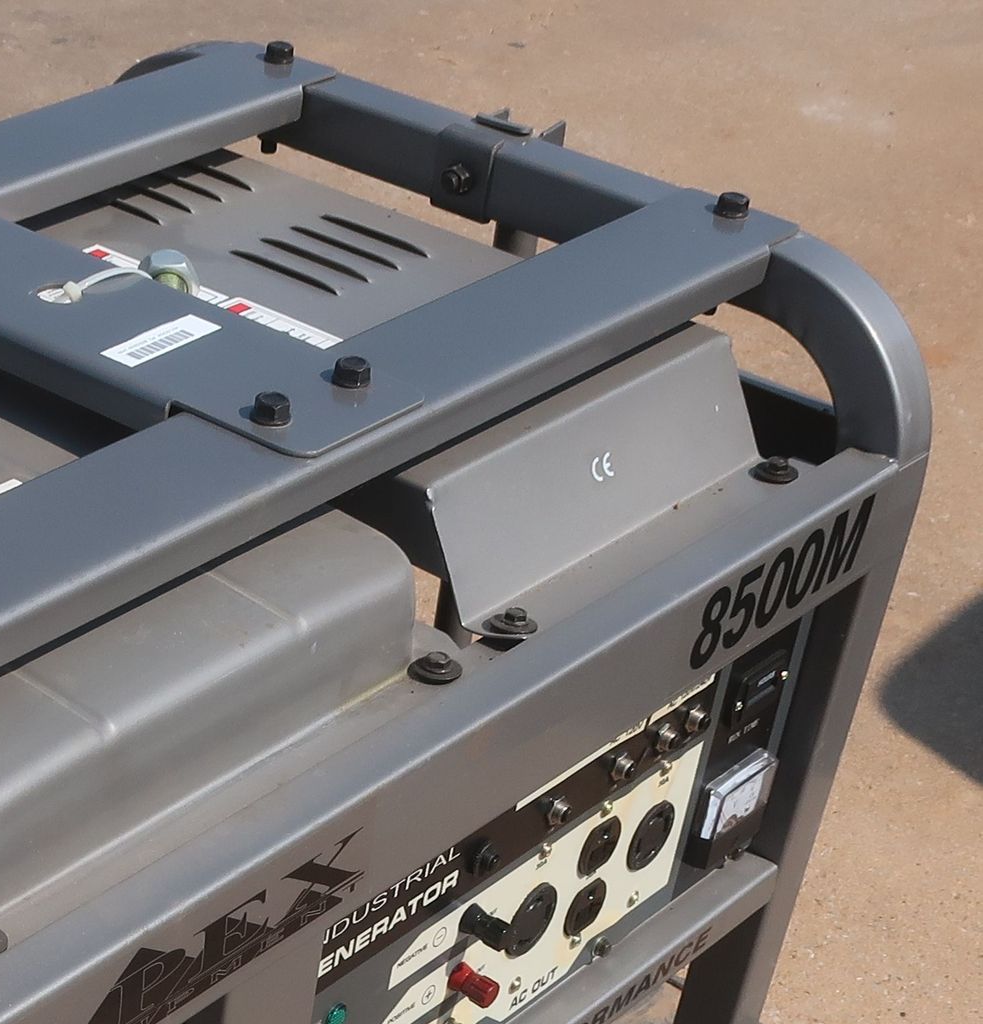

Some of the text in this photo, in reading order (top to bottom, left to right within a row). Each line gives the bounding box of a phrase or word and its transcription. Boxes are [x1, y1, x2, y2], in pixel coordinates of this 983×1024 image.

[591, 451, 615, 482] CE
[689, 492, 877, 670] 8500M
[322, 847, 461, 945] DUSTRIAL
[317, 869, 459, 979] ENERATOR
[396, 943, 428, 969] NEGATIVE
[509, 966, 558, 1011] AC OUT
[387, 1001, 416, 1024] POSITIVE
